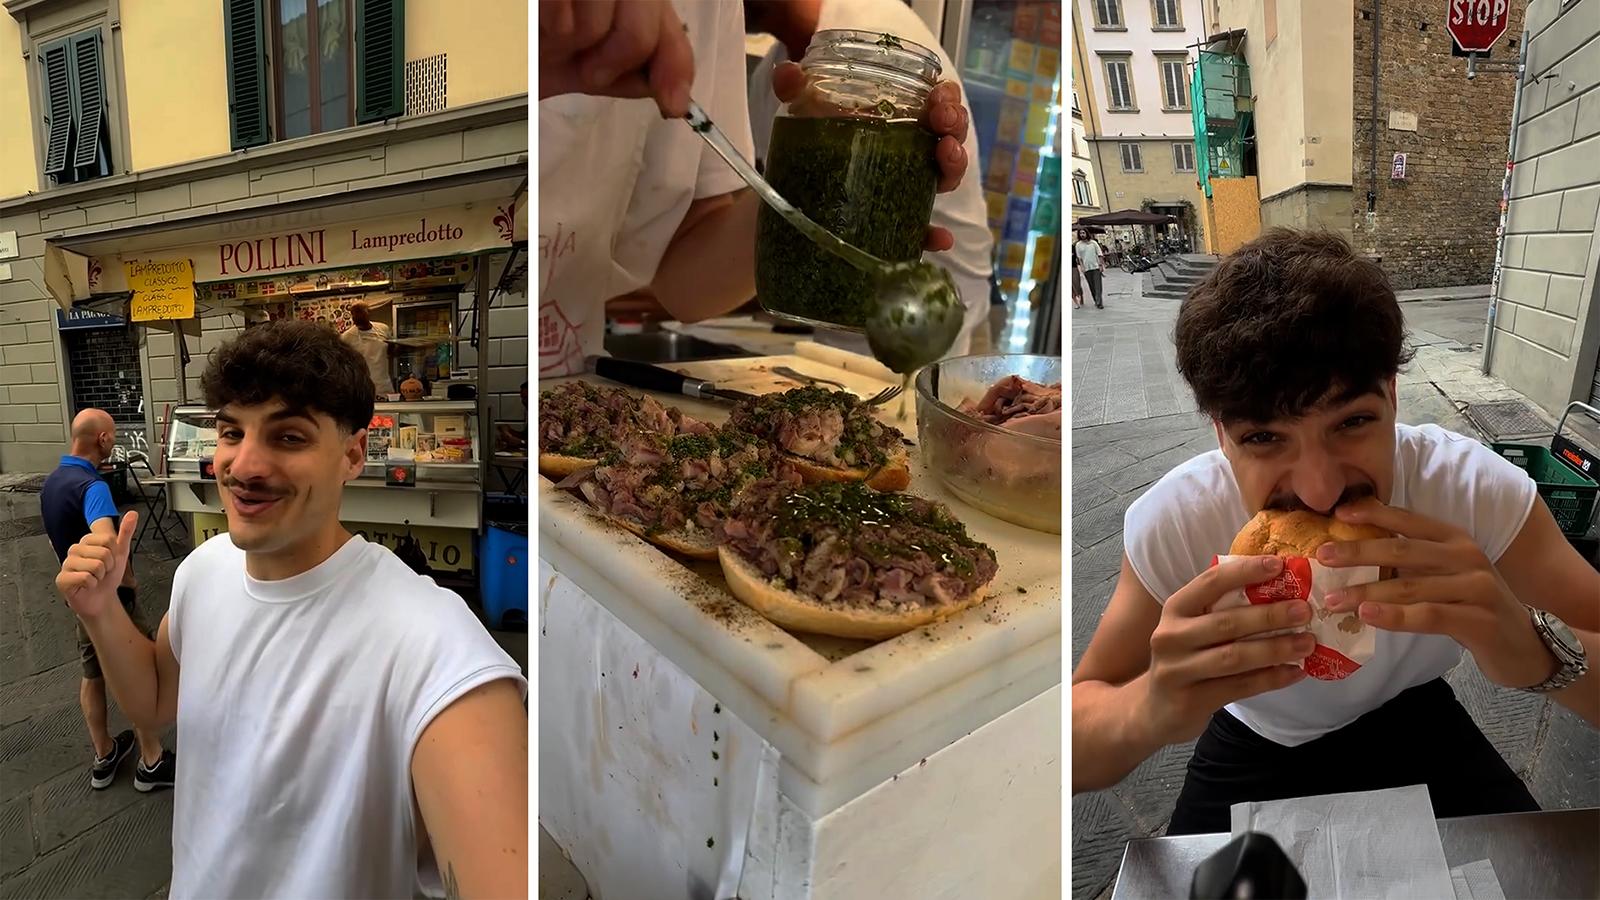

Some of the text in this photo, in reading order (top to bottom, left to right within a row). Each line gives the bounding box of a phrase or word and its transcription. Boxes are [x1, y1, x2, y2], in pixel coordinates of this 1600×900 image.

[1452, 0, 1506, 26] STOP
[219, 229, 327, 275] POLLINI
[351, 218, 463, 252] Lampredotto
